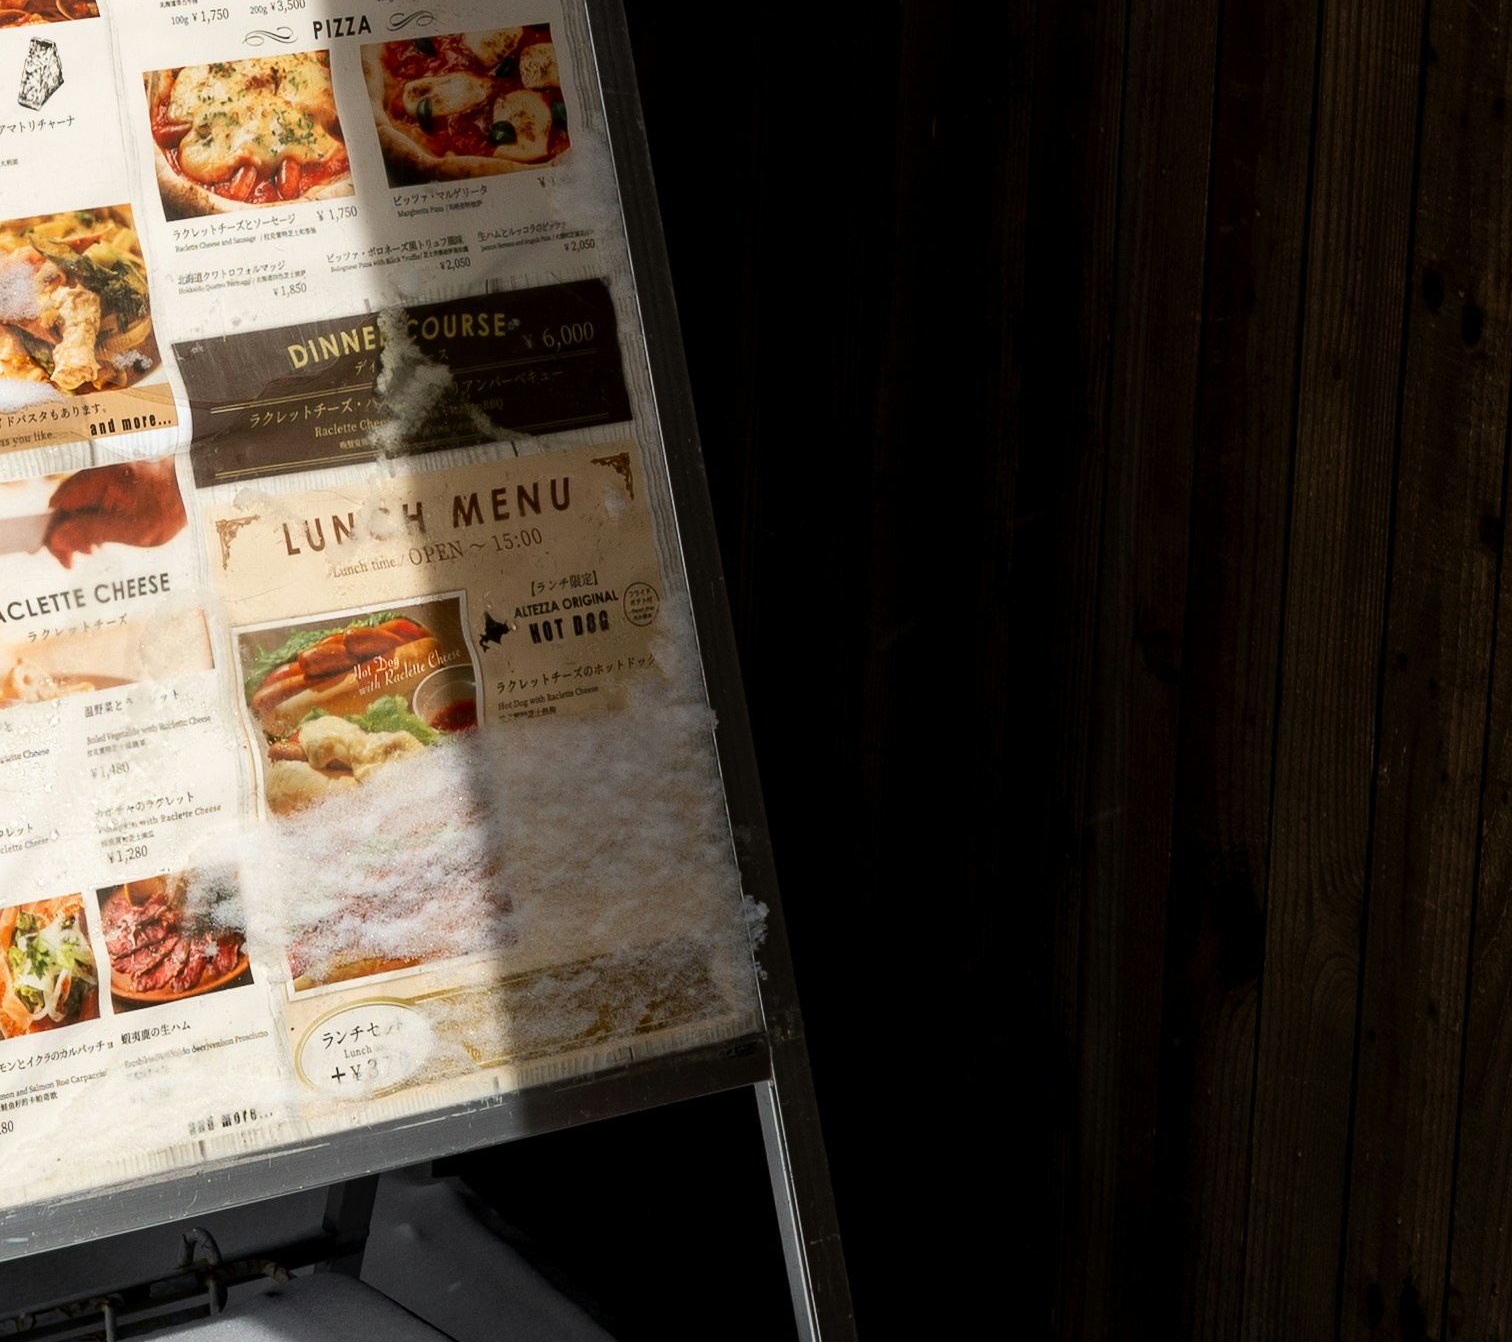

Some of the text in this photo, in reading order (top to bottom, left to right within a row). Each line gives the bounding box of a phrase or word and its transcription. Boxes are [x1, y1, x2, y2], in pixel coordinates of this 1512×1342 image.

[172, 15, 189, 26] 100g
[250, 6, 268, 15] 200g
[312, 14, 372, 40] PIZZA
[393, 184, 487, 207] ピッツァ・マルゲリータ
[173, 213, 296, 240] ラクレットチーズとソーセージ
[178, 260, 285, 285] 北海道クワトロフォルマッジ
[90, 417, 118, 437] and
[12, 435, 31, 449] you
[282, 477, 571, 556] LUNH MENU
[372, 555, 397, 570] time
[409, 540, 465, 566] OPEN
[494, 526, 543, 552] 15:00
[94, 573, 171, 604] CHEESE
[531, 570, 599, 597] 【ランチ限定】
[514, 590, 619, 619] ALTEZZA ORIGINAL
[27, 613, 127, 643] ラクレットチーズ
[529, 610, 610, 644] HOT DOG
[359, 649, 460, 696] with Raclette Cheese
[373, 655, 400, 672] Dog
[498, 701, 512, 711] Hot
[514, 698, 529, 709] Dog
[530, 694, 545, 705] with
[107, 845, 148, 864] ¥1,280
[121, 1021, 191, 1045] 蝦夷鹿の生ハム
[344, 1044, 372, 1059] Lunch
[16, 1087, 28, 1097] and
[29, 1081, 55, 1092] Salmon
